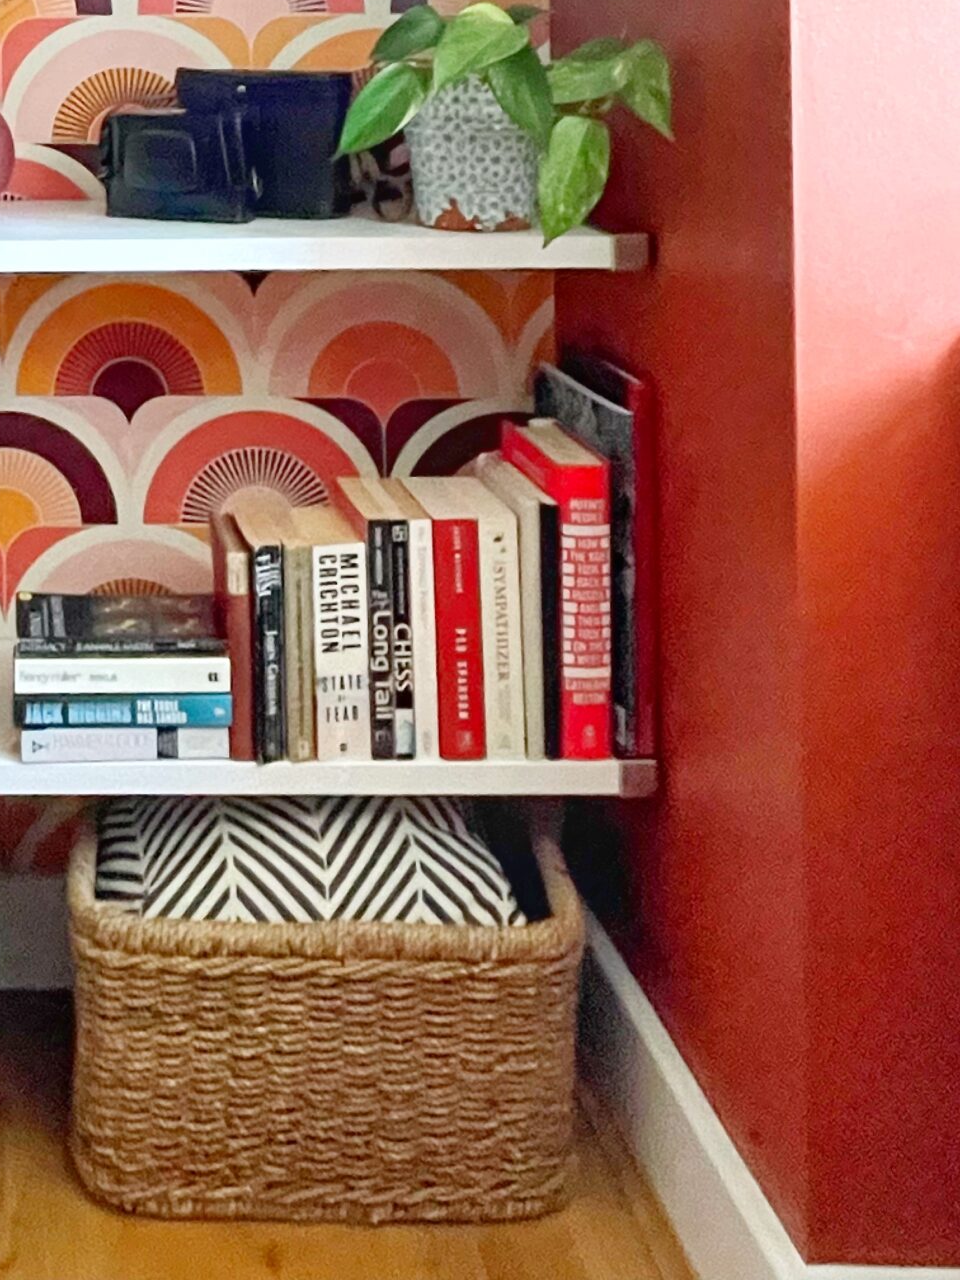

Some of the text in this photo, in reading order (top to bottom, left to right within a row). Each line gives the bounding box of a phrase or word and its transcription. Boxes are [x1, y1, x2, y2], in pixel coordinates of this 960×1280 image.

[318, 554, 339, 654] CRICHTON
[340, 552, 362, 652] MICHAEL
[494, 564, 510, 681] SYMPATHIZER
[370, 610, 392, 671] Long
[393, 623, 414, 693] CHESS
[320, 674, 363, 693] STATE
[326, 705, 359, 723] FEAR
[374, 677, 394, 720] Tail
